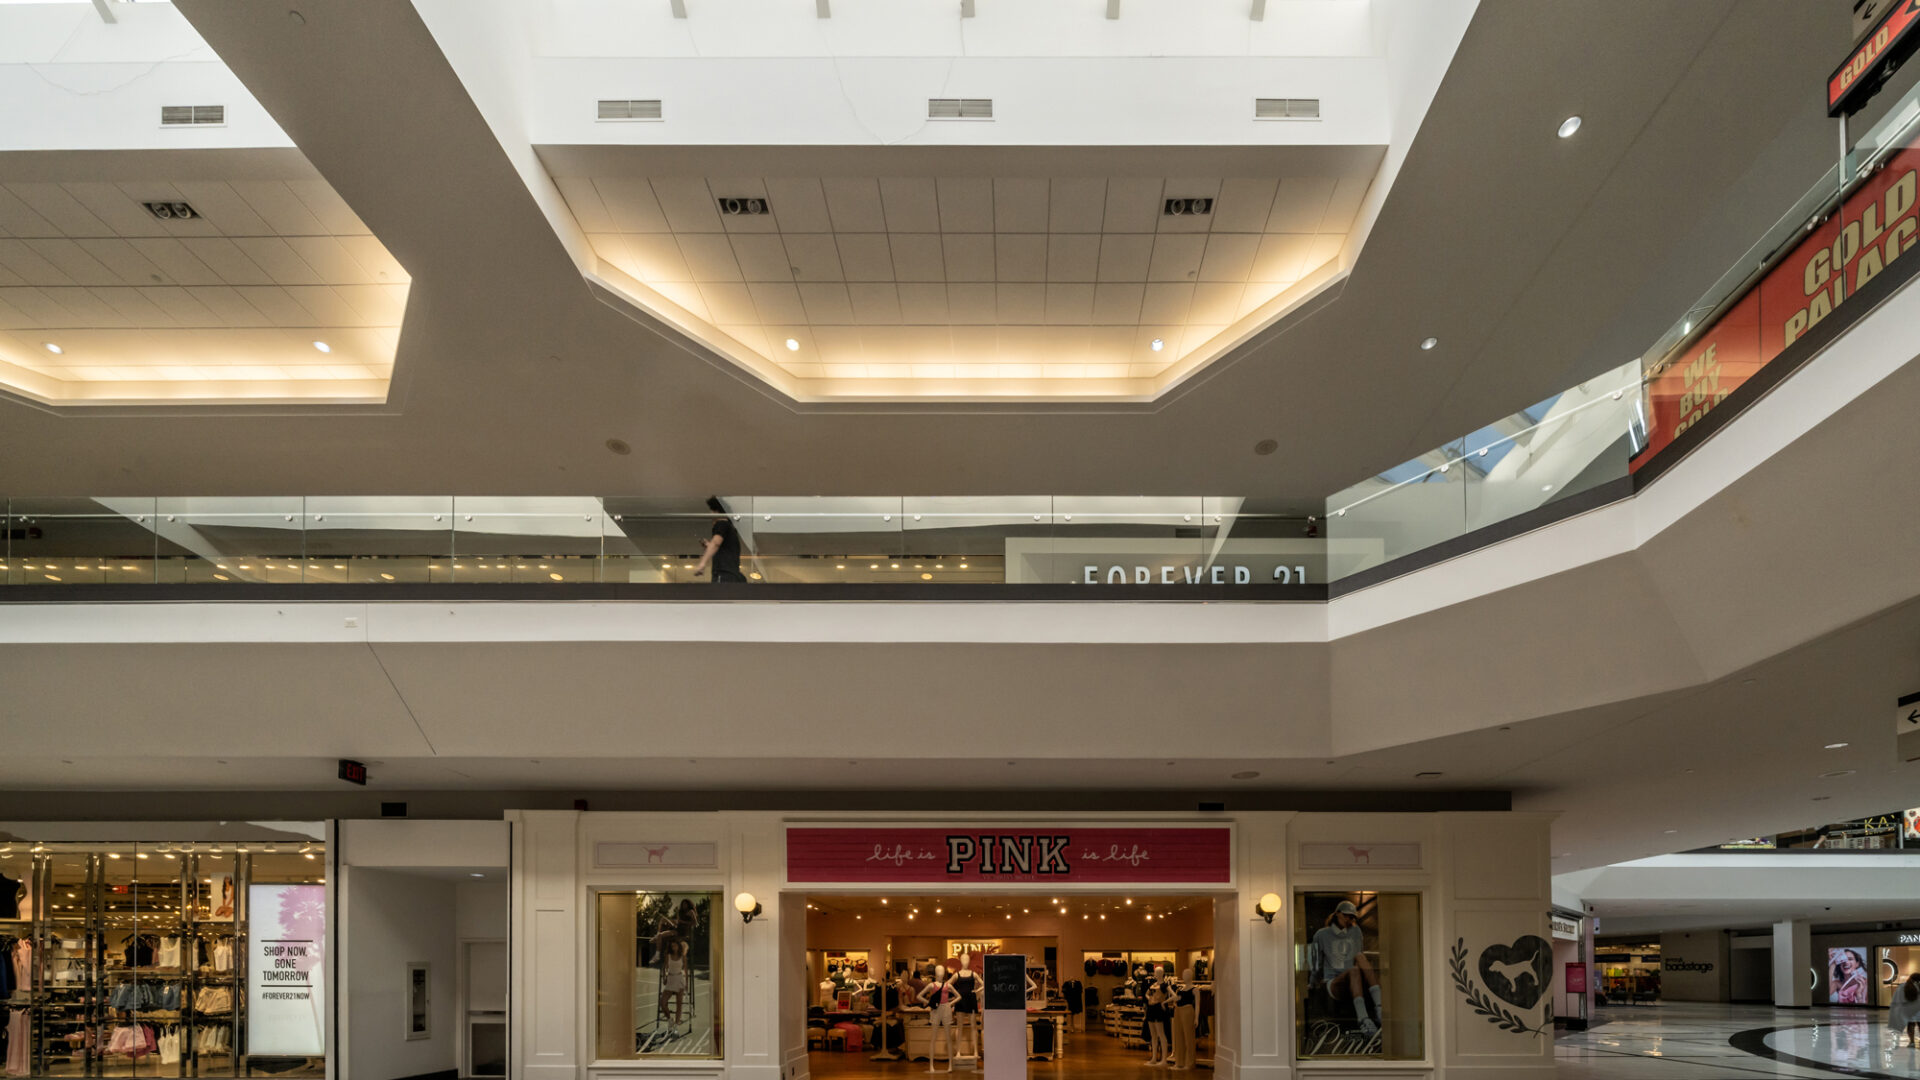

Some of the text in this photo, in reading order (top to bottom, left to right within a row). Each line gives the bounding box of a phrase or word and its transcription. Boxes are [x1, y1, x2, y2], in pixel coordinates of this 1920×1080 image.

[1840, 26, 1889, 90] GOLD
[1803, 168, 1918, 297] GOLD
[1683, 342, 1717, 389] WE
[1679, 363, 1722, 419] BUY
[866, 835, 1150, 873] life is PINK is life
[263, 946, 308, 958] SHOP NOW,
[274, 958, 297, 969] GONE
[1665, 961, 1714, 974] backstage
[262, 970, 309, 981] TOMORROW
[1310, 1019, 1383, 1055] Pink
